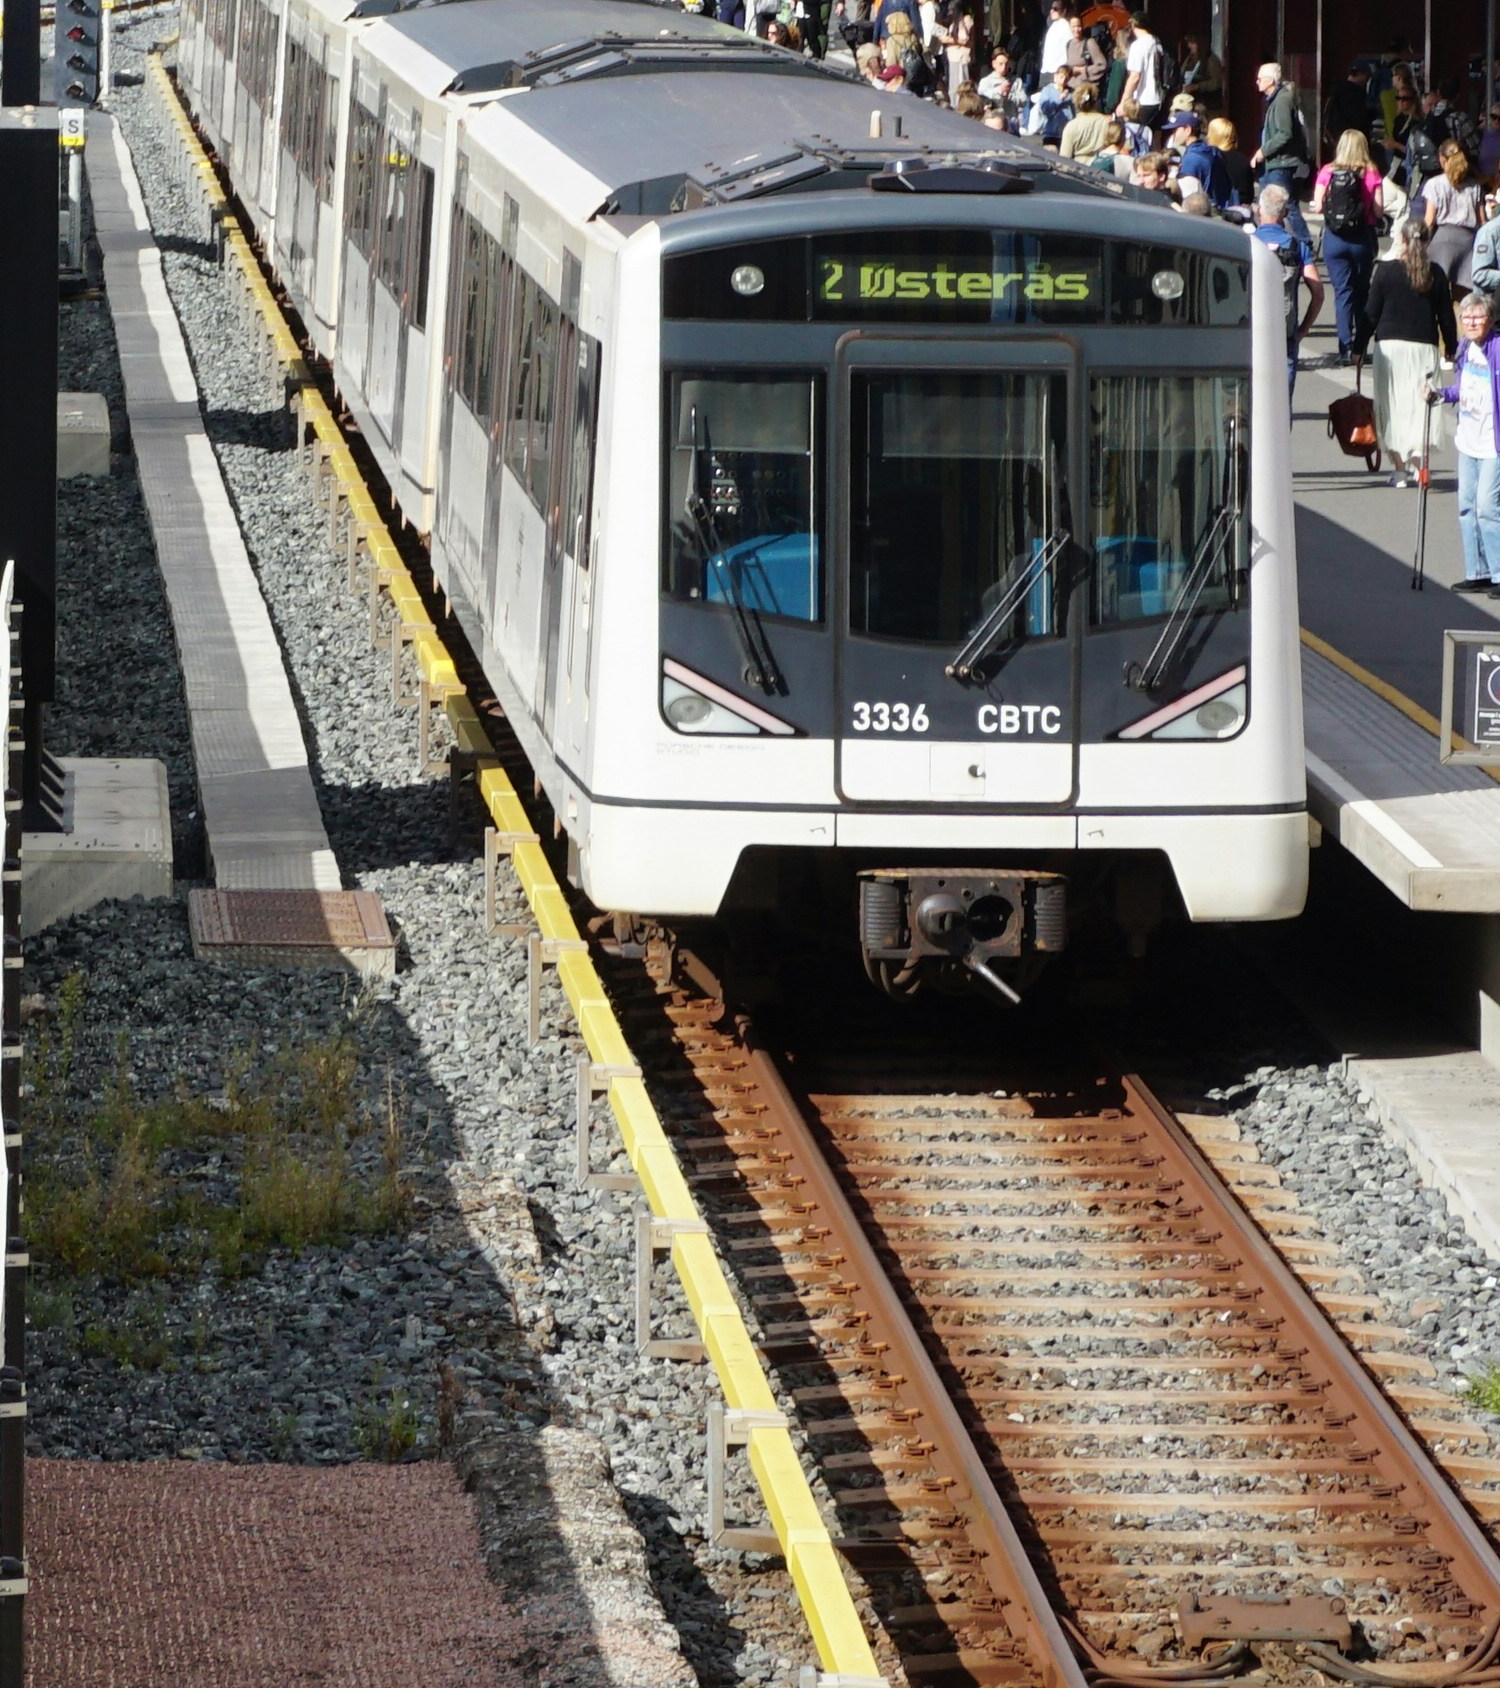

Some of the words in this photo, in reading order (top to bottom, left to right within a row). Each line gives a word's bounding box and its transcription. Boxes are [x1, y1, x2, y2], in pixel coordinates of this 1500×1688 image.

[68, 119, 79, 134] S
[820, 262, 843, 300] 2
[860, 262, 1090, 300] Østerås
[852, 703, 930, 732] 3336
[978, 705, 1062, 734] CBTC
